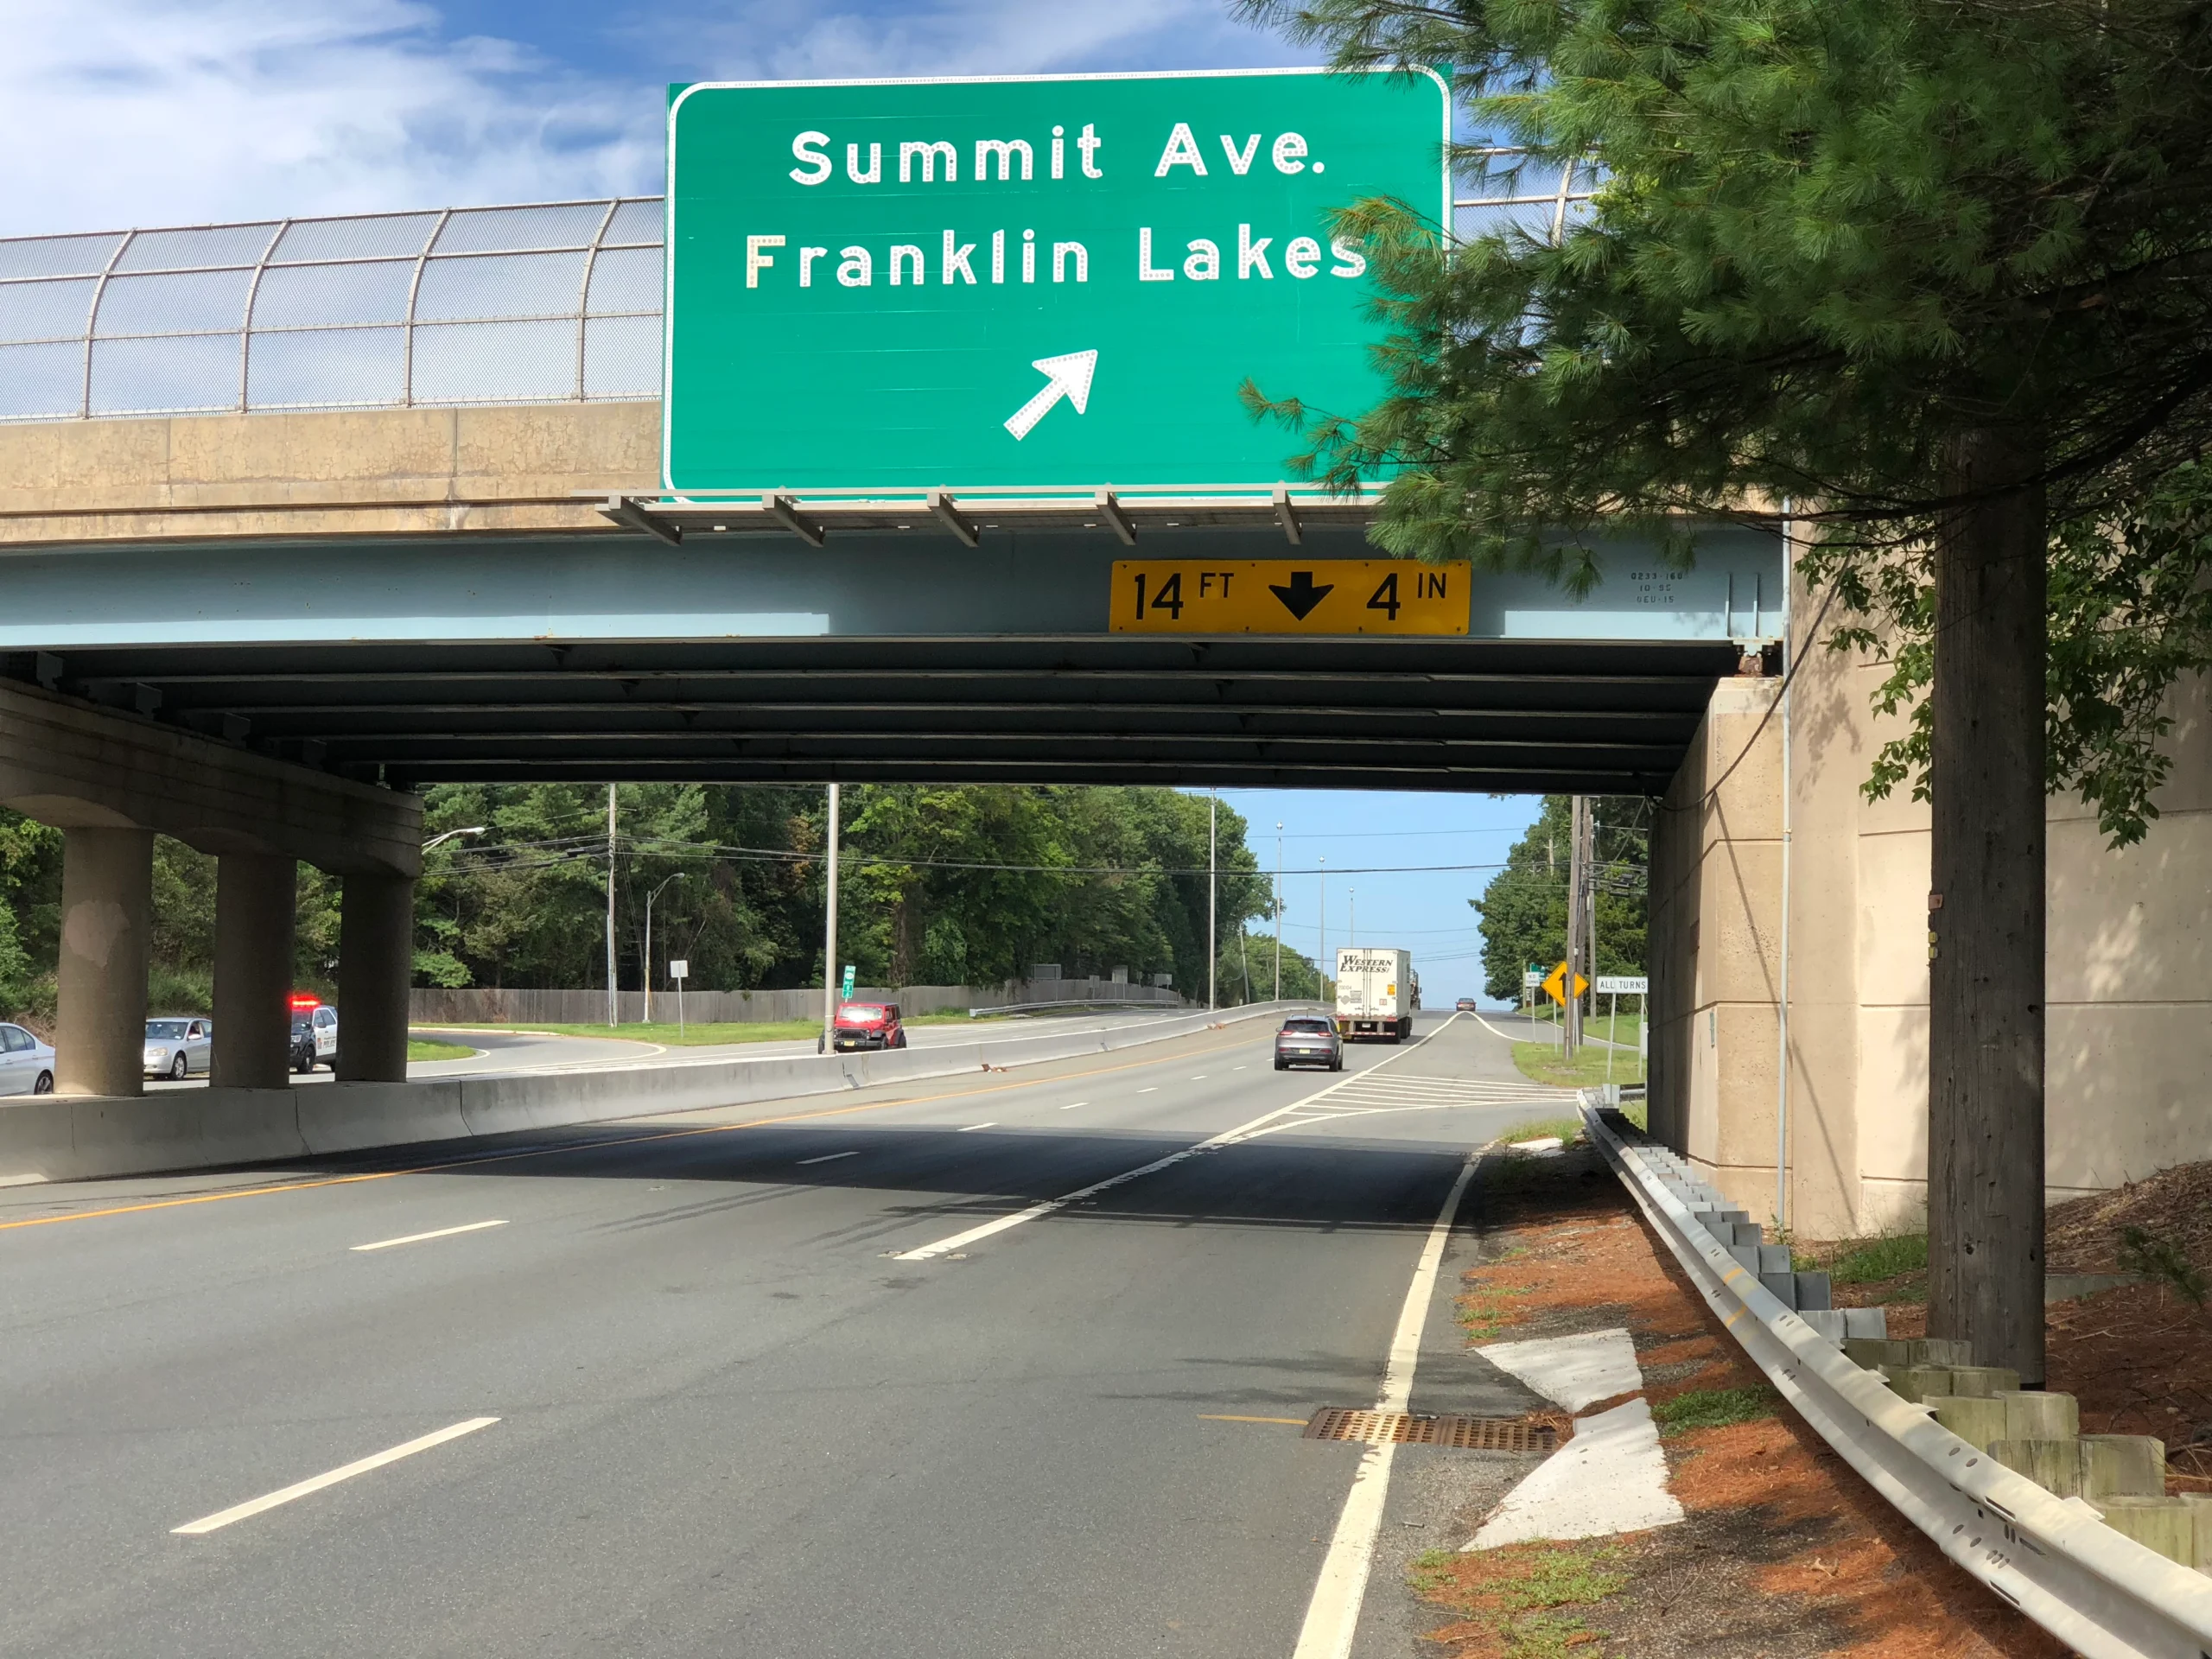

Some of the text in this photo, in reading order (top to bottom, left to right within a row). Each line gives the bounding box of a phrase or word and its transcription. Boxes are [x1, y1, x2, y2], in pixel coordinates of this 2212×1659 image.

[788, 122, 1325, 186] Summit Ave.
[745, 223, 1370, 289] Franklin Lakes
[1134, 572, 1447, 621] 14 FT 4 IN
[1343, 955, 1394, 967] WESTERN
[1599, 980, 1646, 989] ALL TURNS
